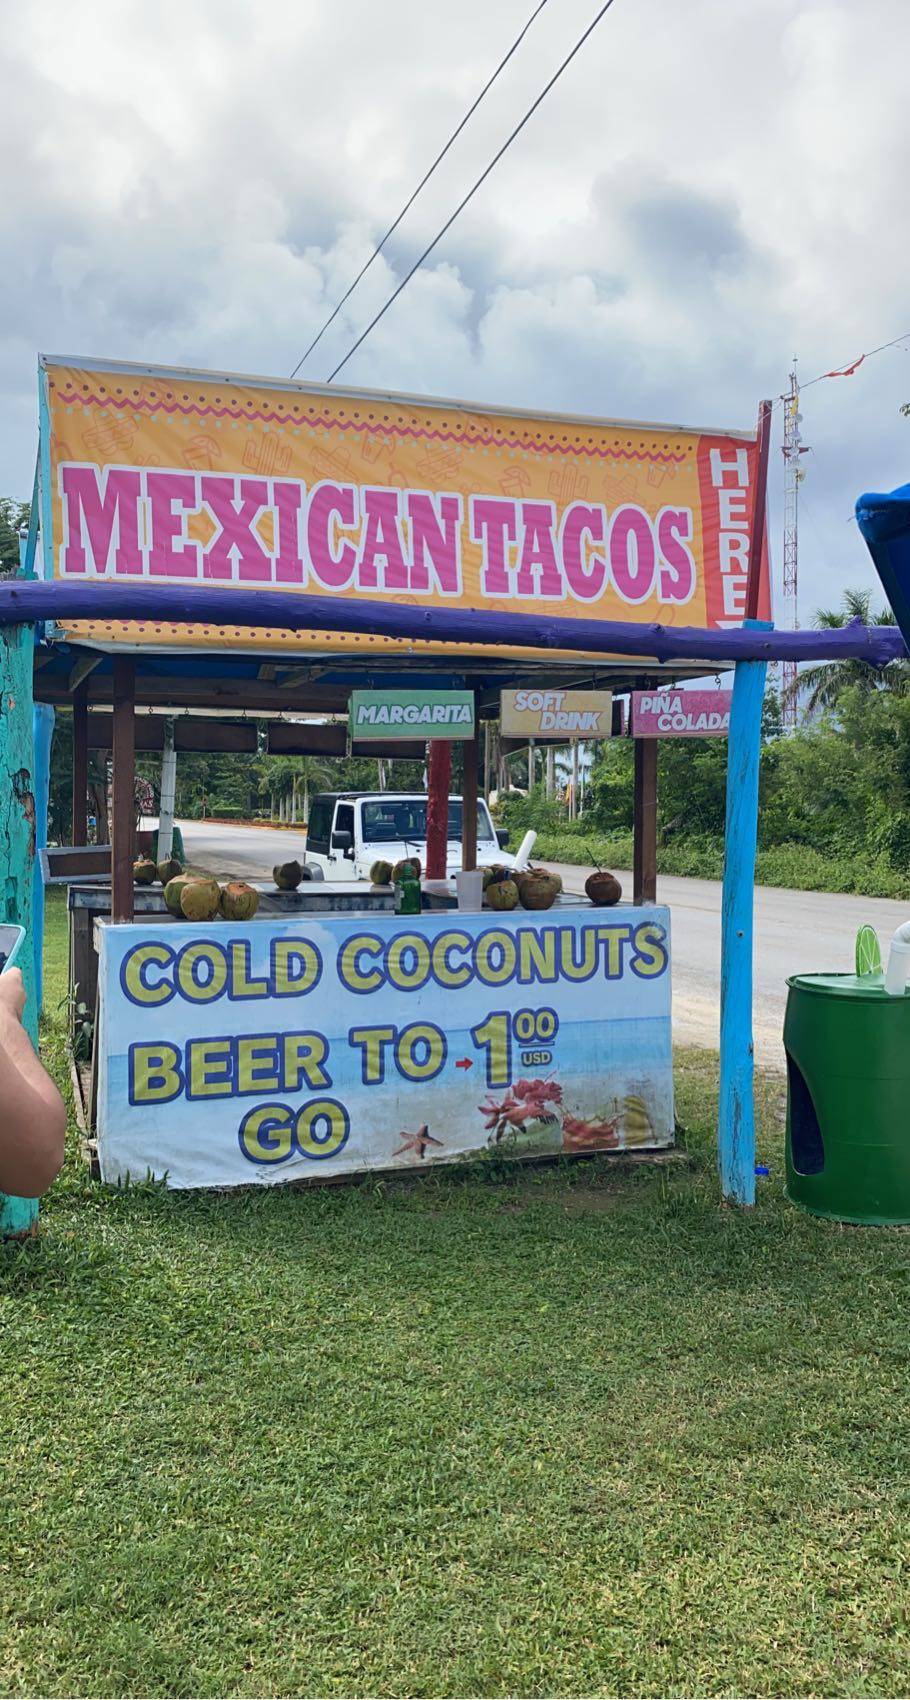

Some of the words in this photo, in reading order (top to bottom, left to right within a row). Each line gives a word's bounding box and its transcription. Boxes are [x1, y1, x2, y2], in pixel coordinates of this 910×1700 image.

[61, 464, 466, 597] MEXICAN
[469, 495, 697, 605] TACOS
[709, 448, 750, 616] HERE
[357, 704, 473, 725] MARGARITA
[514, 691, 564, 711] SOFT
[539, 711, 601, 730] DRINK
[640, 690, 682, 714] PIÑA
[119, 932, 323, 1008] COLD
[336, 919, 668, 995] COCONUTS
[128, 1029, 333, 1106] BEER
[349, 1021, 448, 1086] TO
[520, 1050, 553, 1067] USD
[238, 1096, 351, 1165] GO
